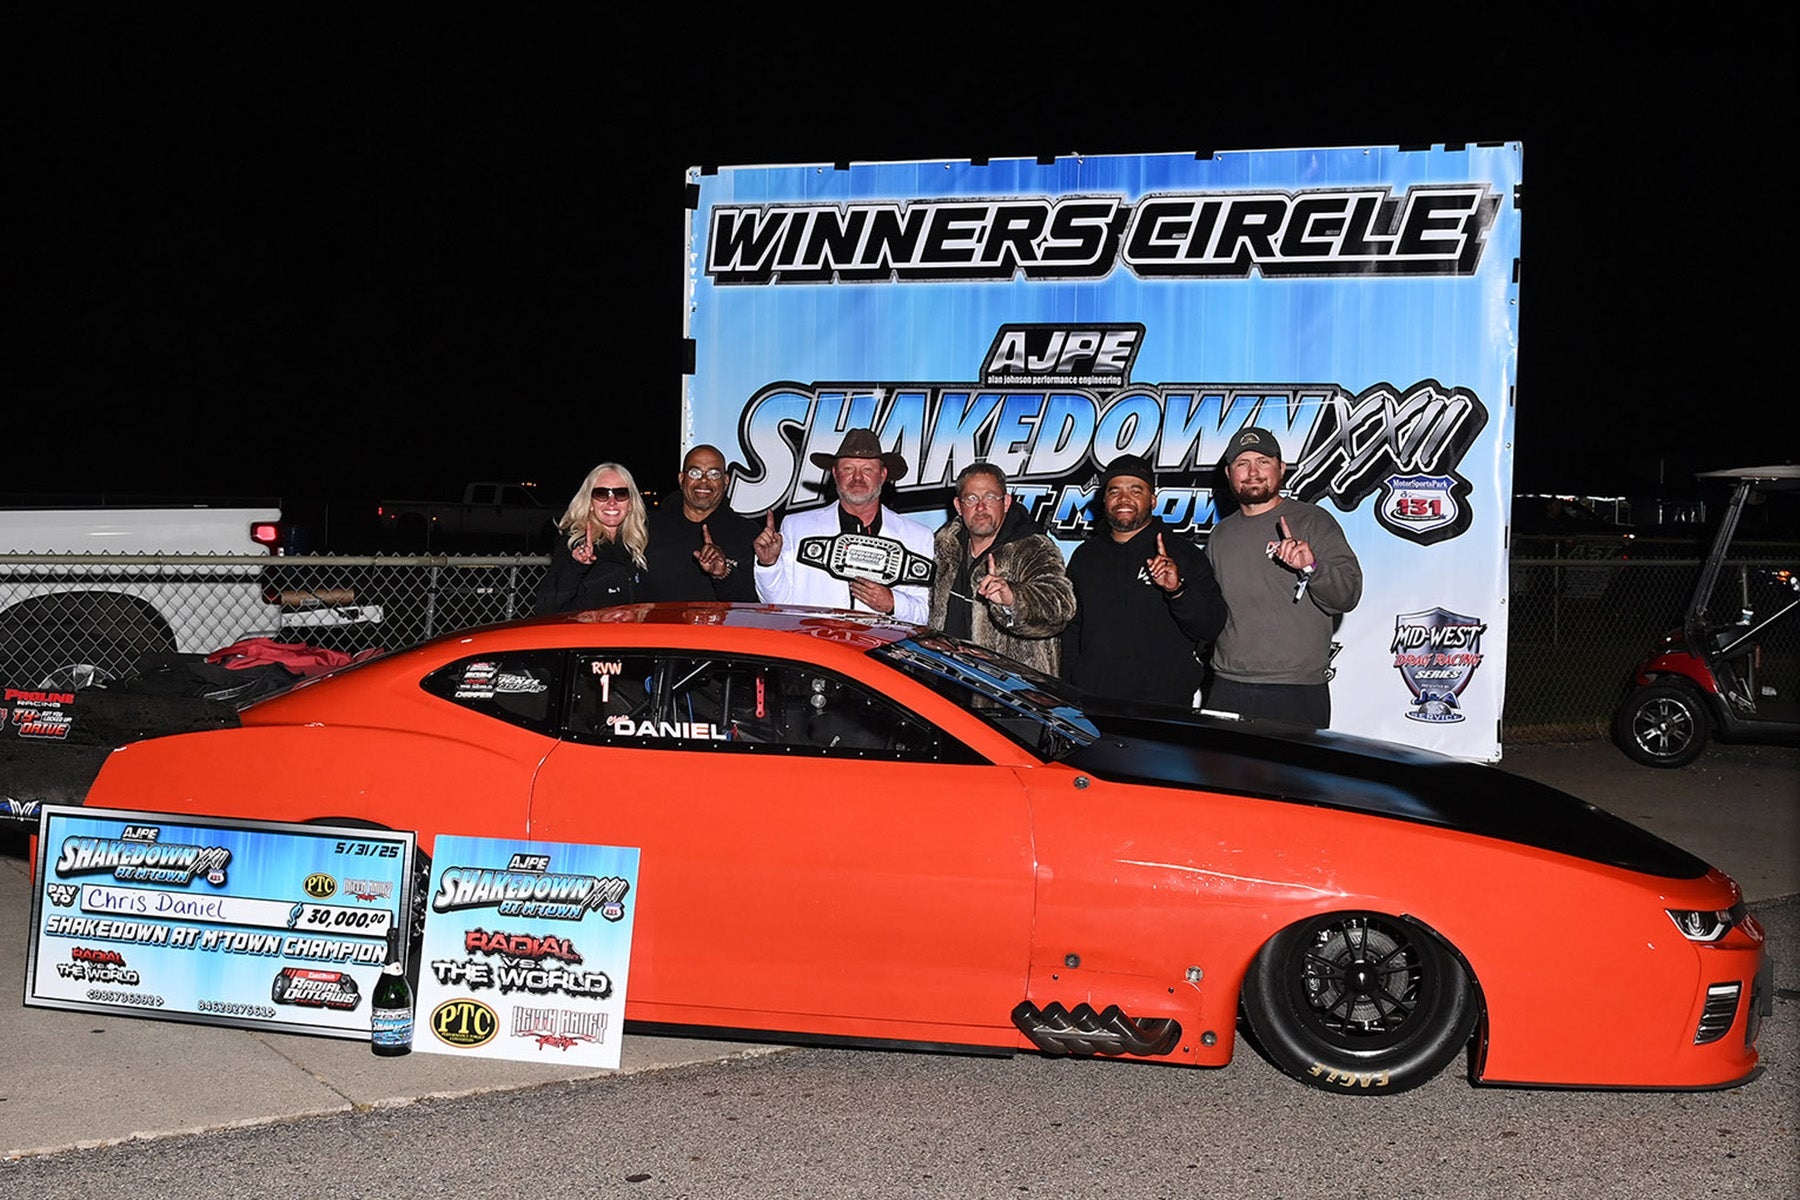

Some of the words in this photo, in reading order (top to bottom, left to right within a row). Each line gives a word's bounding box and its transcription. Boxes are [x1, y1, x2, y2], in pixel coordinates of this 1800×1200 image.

[706, 197, 1122, 282] WINNERS
[1122, 187, 1492, 272] CIRCLE
[988, 331, 1138, 373] AJPE
[987, 375, 1003, 385] alan
[1004, 375, 1031, 386] johnson
[1032, 375, 1078, 386] performance
[1079, 375, 1122, 386] engineering
[729, 386, 1336, 517] SHAKEDOWN
[1288, 386, 1473, 495] XXII
[1396, 498, 1441, 517] 131
[1391, 625, 1484, 652] MID-WEST
[591, 661, 622, 675] RVW
[1395, 653, 1433, 667] DRAG
[1433, 653, 1482, 667] RACING
[1414, 669, 1461, 679] SERIES
[4, 688, 75, 704] PROLINE
[600, 674, 610, 702] 1
[17, 700, 61, 708] RACING
[21, 722, 67, 736] DRIVE
[614, 720, 728, 740] DANIEL
[122, 826, 159, 841] AJPE
[57, 836, 199, 872] SHAKEDOWN
[334, 842, 400, 858] 5/31/25
[509, 855, 549, 870] AJPE
[48, 884, 77, 896] PAY
[307, 876, 333, 893] PTC
[433, 867, 595, 908] SHAKEDOWN
[51, 893, 72, 904] TO
[88, 888, 148, 912] Chris
[155, 892, 227, 919] Daniel
[500, 901, 523, 915] AT
[287, 901, 304, 929] $
[46, 915, 170, 944] SHAKEDOWN
[171, 927, 200, 949] AT
[202, 930, 282, 957] M'TOWN
[283, 938, 387, 964] CHAMPION
[465, 931, 580, 960] RADIAL
[72, 948, 124, 964] RADIAL
[57, 964, 84, 978] THE
[87, 967, 139, 983] WORLD
[432, 960, 489, 984] THE
[499, 967, 608, 993] WORLD
[283, 988, 357, 1003] OUTLAWS
[438, 1003, 491, 1036] PTC
[559, 1010, 608, 1045] HANEY
[1307, 1061, 1391, 1088] EAGLE
